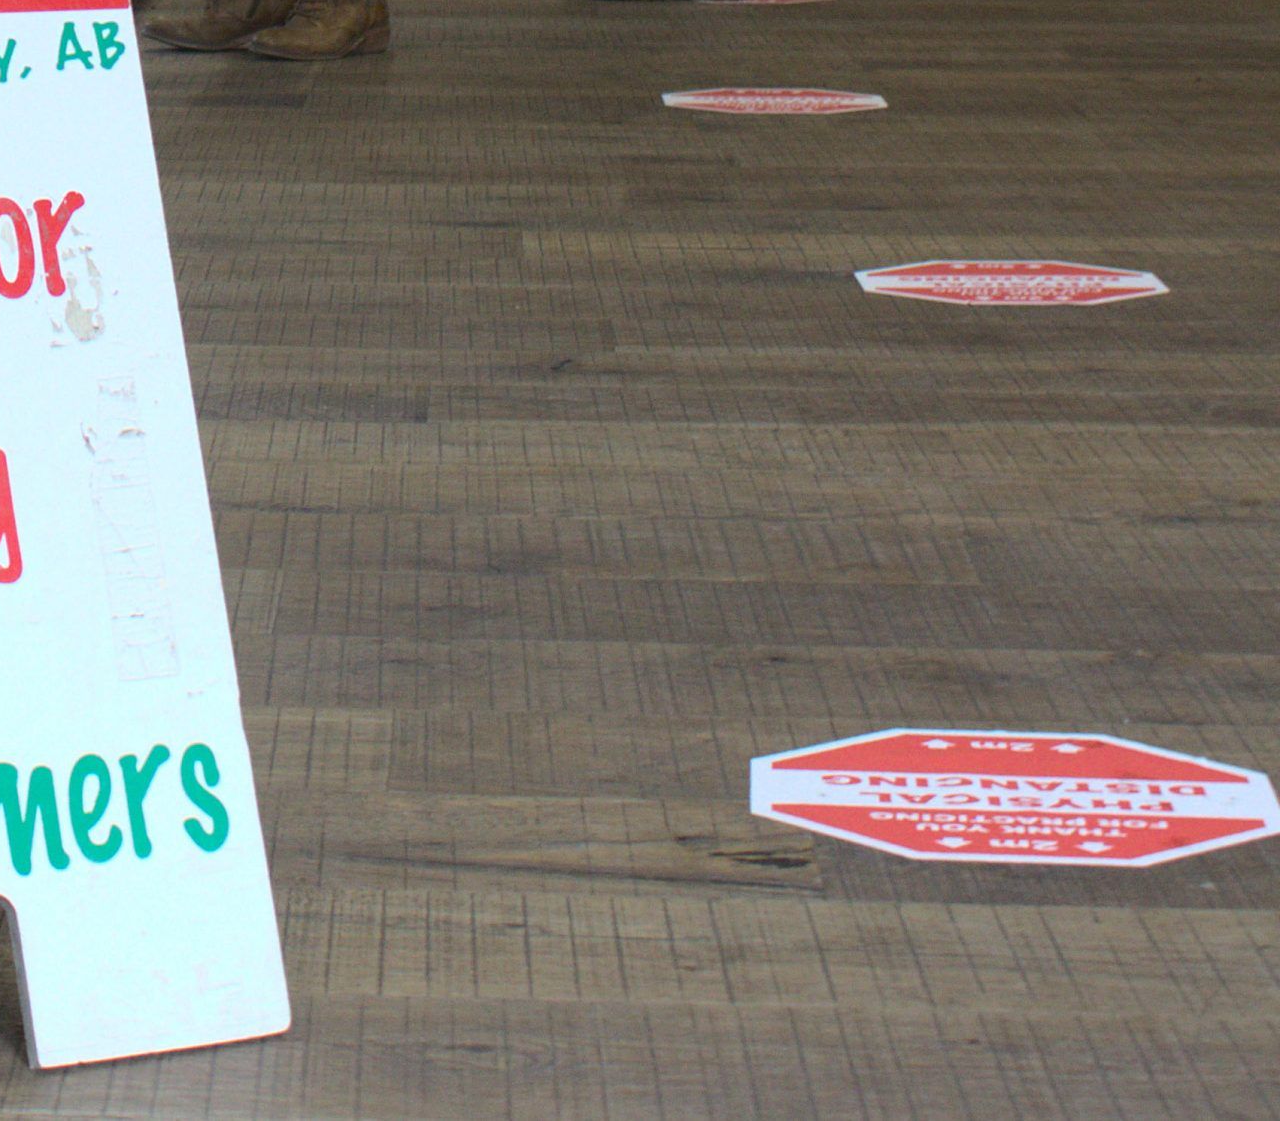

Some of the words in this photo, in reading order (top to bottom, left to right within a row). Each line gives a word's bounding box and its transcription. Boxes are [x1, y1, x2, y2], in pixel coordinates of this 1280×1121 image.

[55, 20, 126, 72] AB
[970, 740, 1034, 752] 2m
[821, 774, 1206, 795] DISTANCING
[859, 792, 1174, 812] PHYSICAL
[869, 811, 1087, 827] PRACTICING
[1098, 818, 1169, 830] FOR
[915, 822, 990, 834] YOU
[1001, 824, 1128, 838] THANK
[988, 838, 1059, 852] 2m
